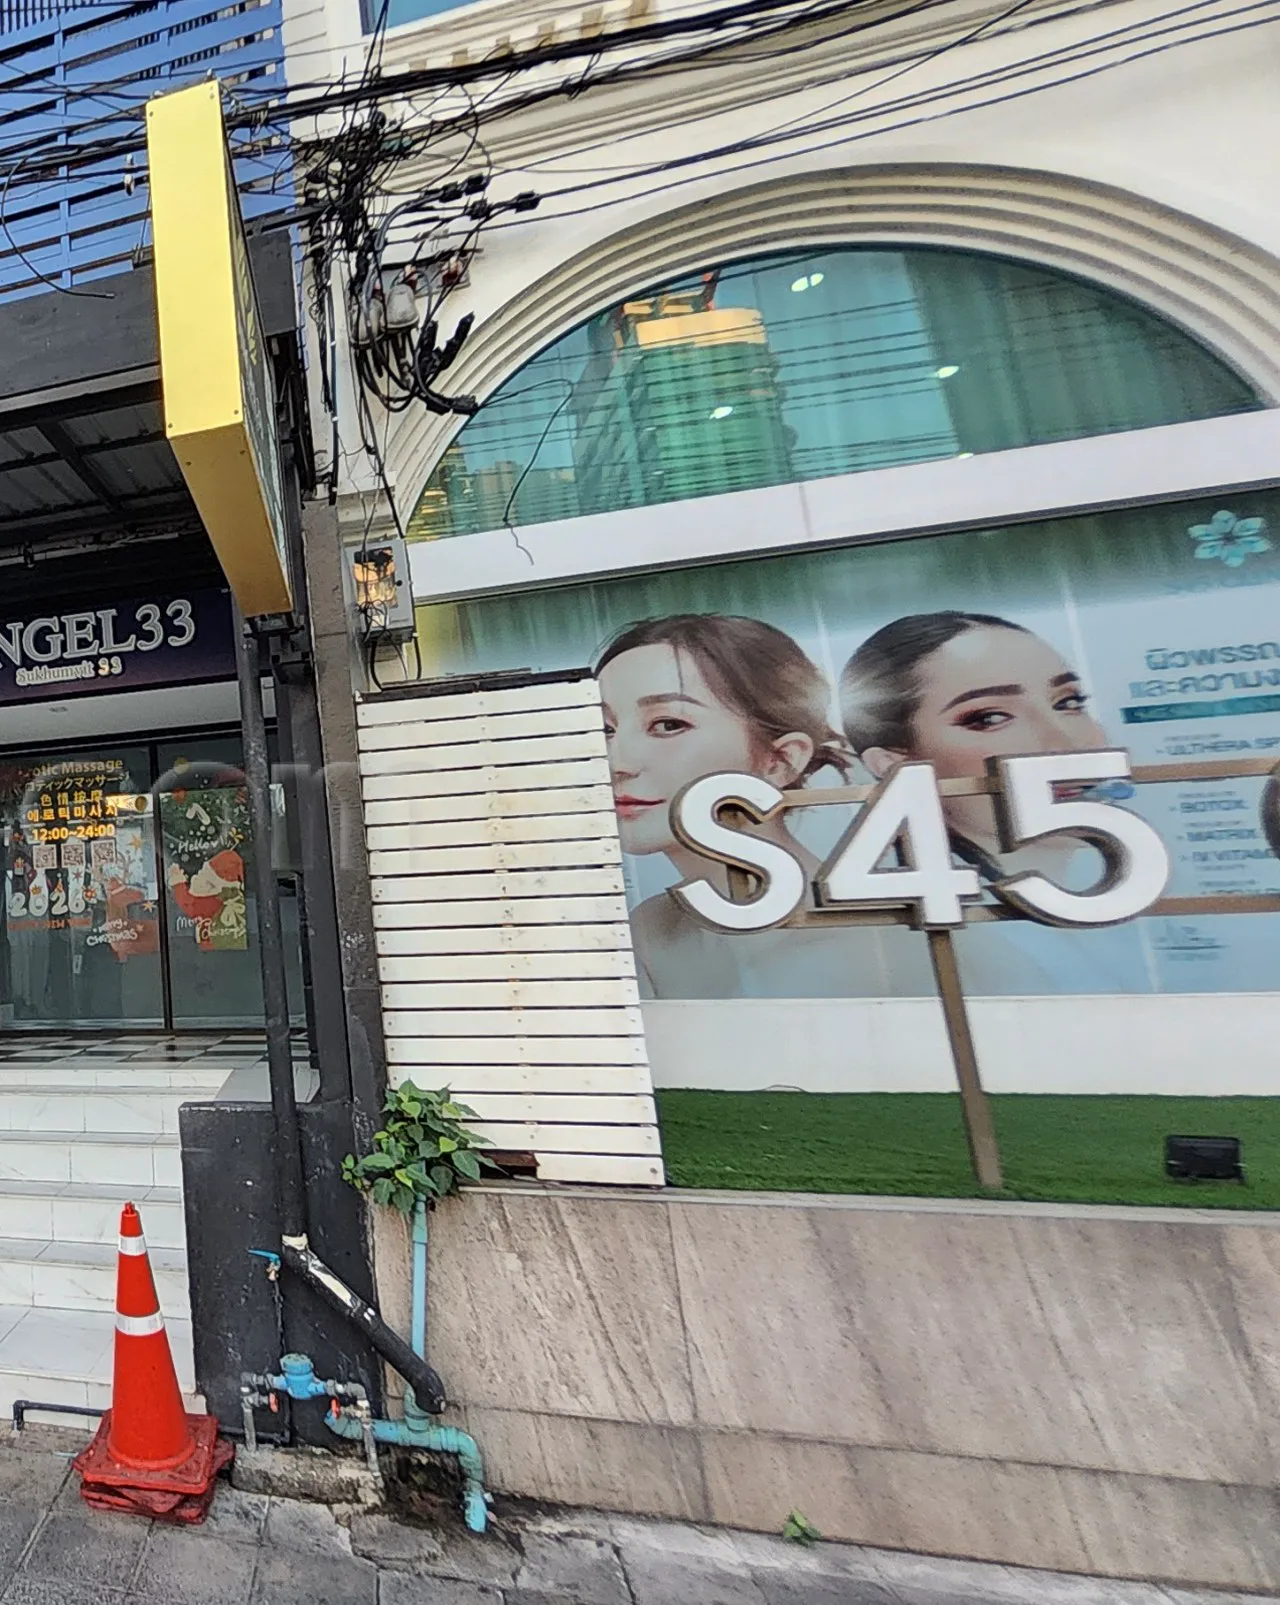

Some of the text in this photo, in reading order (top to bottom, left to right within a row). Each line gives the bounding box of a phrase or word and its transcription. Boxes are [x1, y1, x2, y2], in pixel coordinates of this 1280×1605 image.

[16, 656, 122, 686] Sukhumvit 33
[61, 759, 123, 774] Massage
[667, 747, 1173, 934] S45
